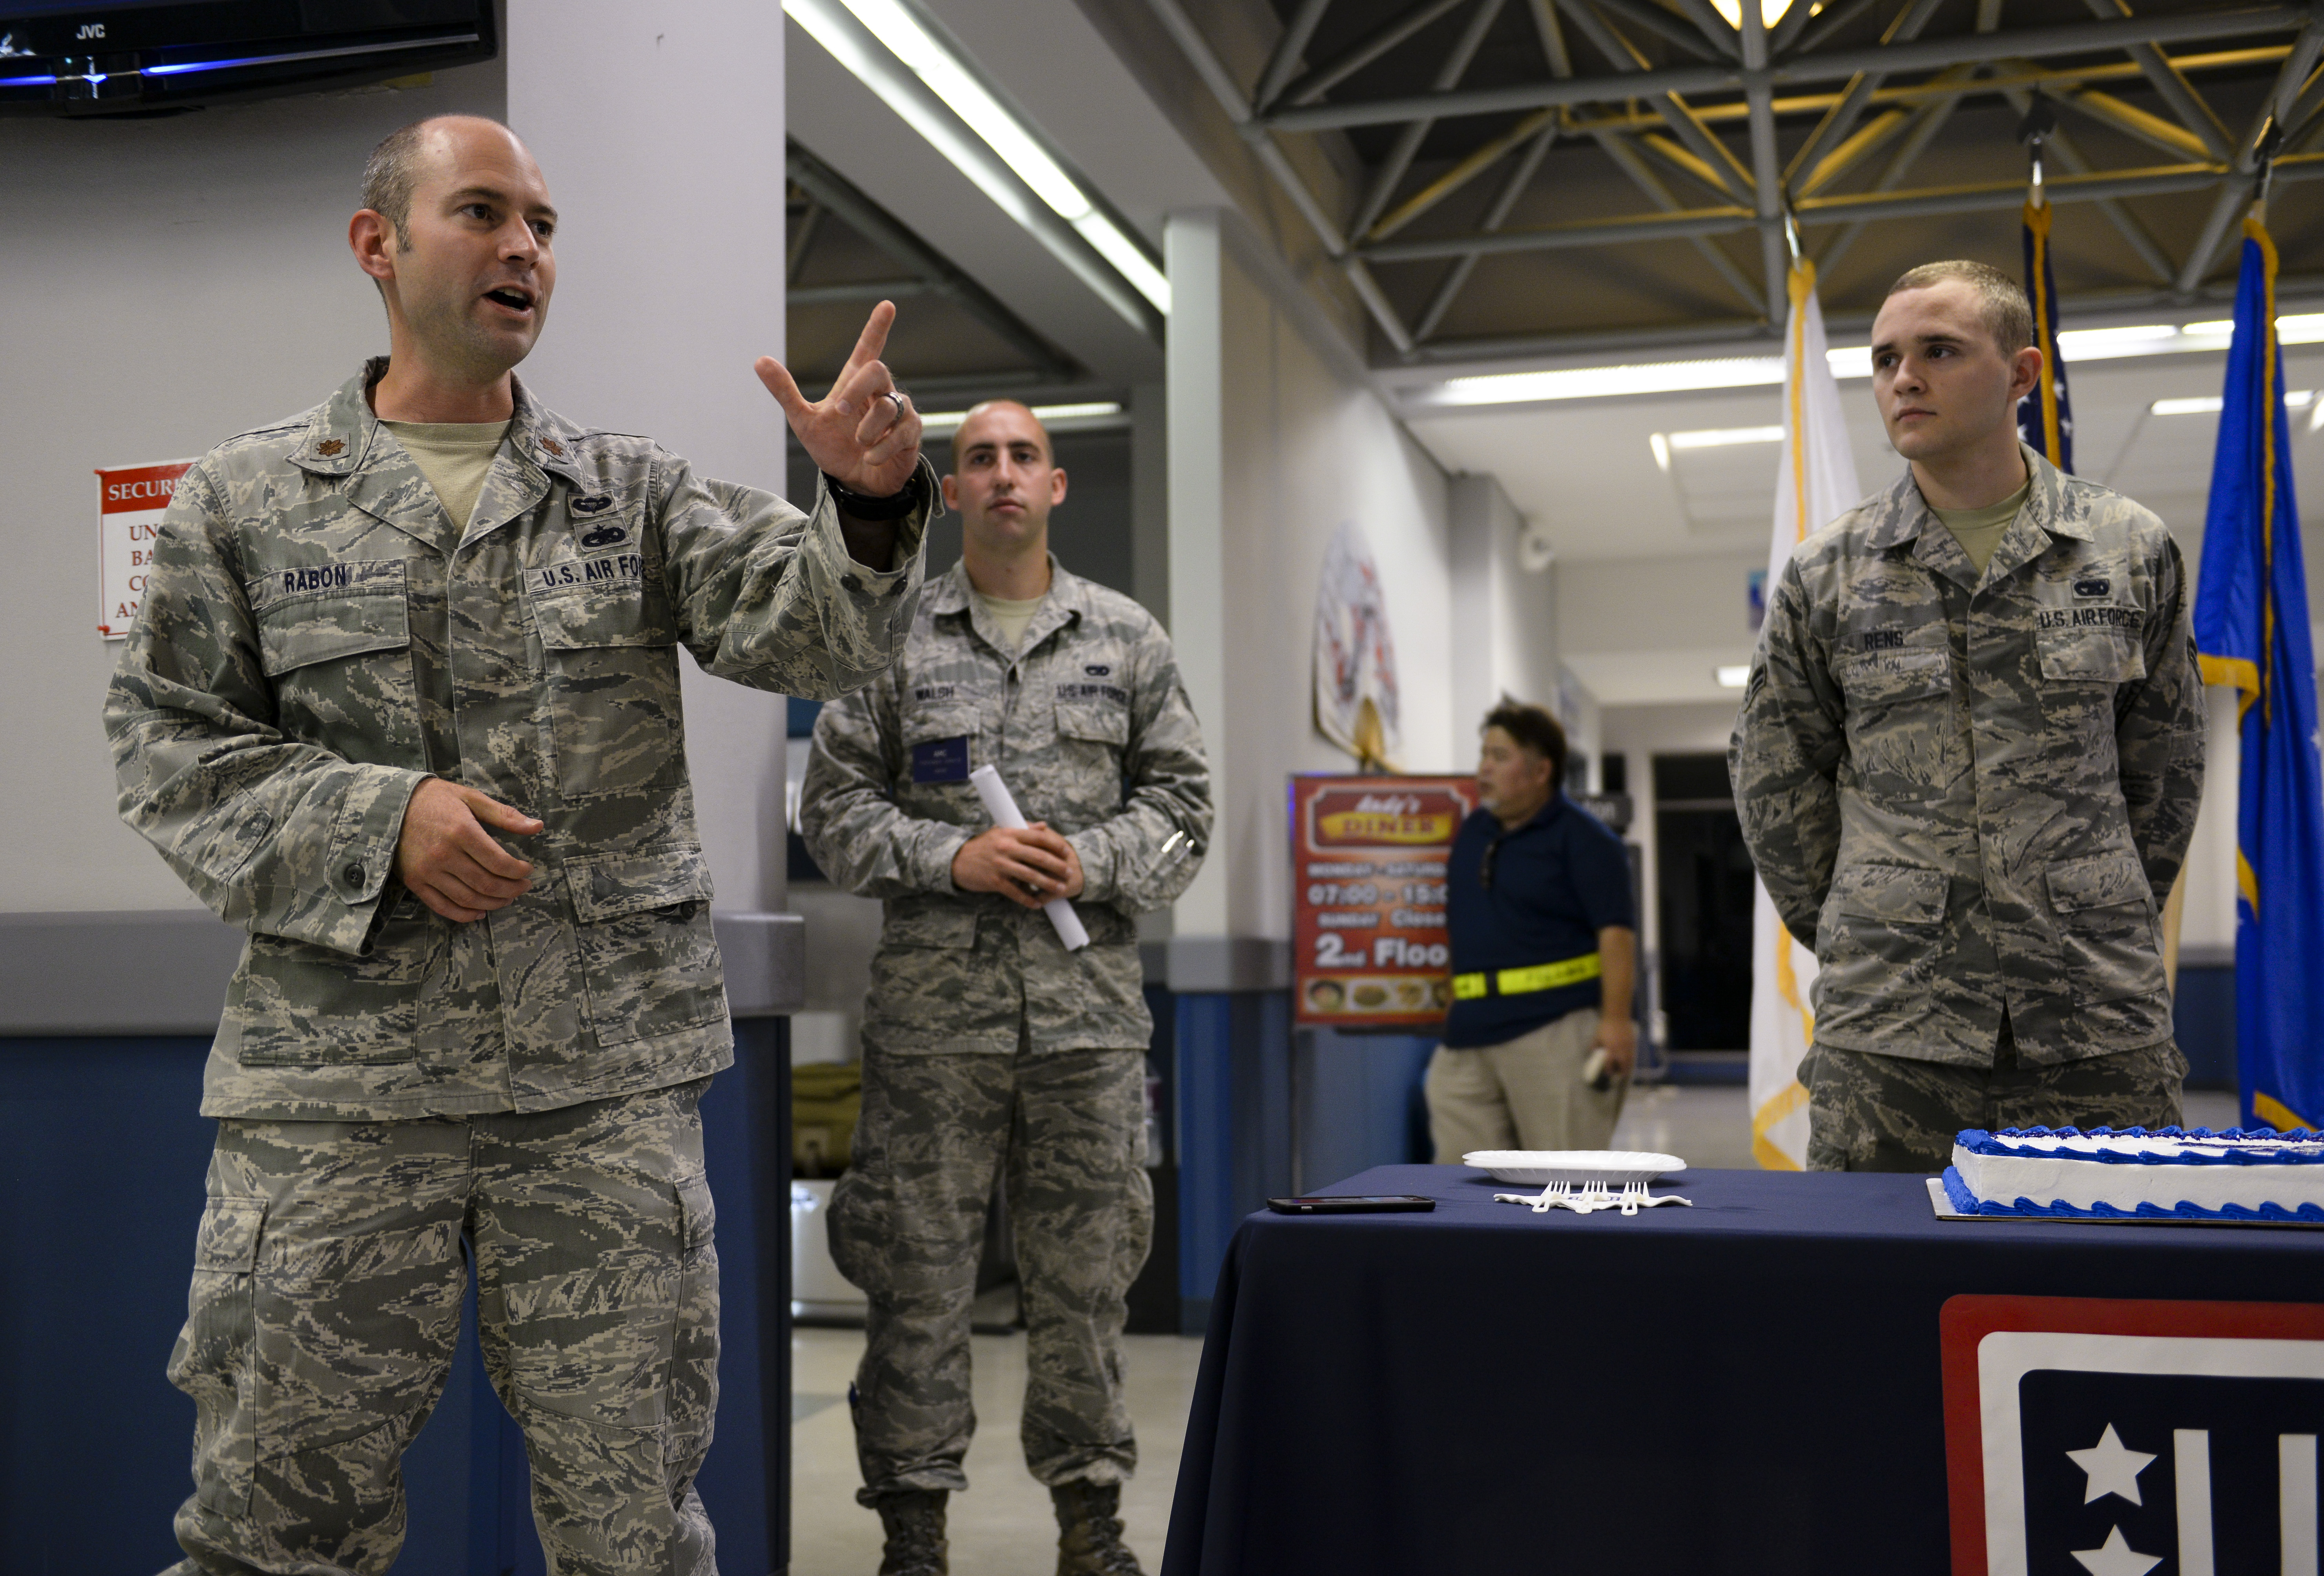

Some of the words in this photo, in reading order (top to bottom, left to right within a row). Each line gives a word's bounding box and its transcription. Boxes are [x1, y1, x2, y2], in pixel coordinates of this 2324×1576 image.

[77, 24, 105, 40] JVC
[284, 565, 346, 593] RABON
[542, 566, 580, 587] U.S.
[585, 559, 615, 581] AIR
[2073, 609, 2097, 627] AIR
[2098, 608, 2140, 628] FORCE
[1864, 630, 1904, 650] RENS
[914, 686, 954, 701] WALSH
[1308, 883, 1377, 905] 07:00
[1374, 937, 1449, 968] Floo
